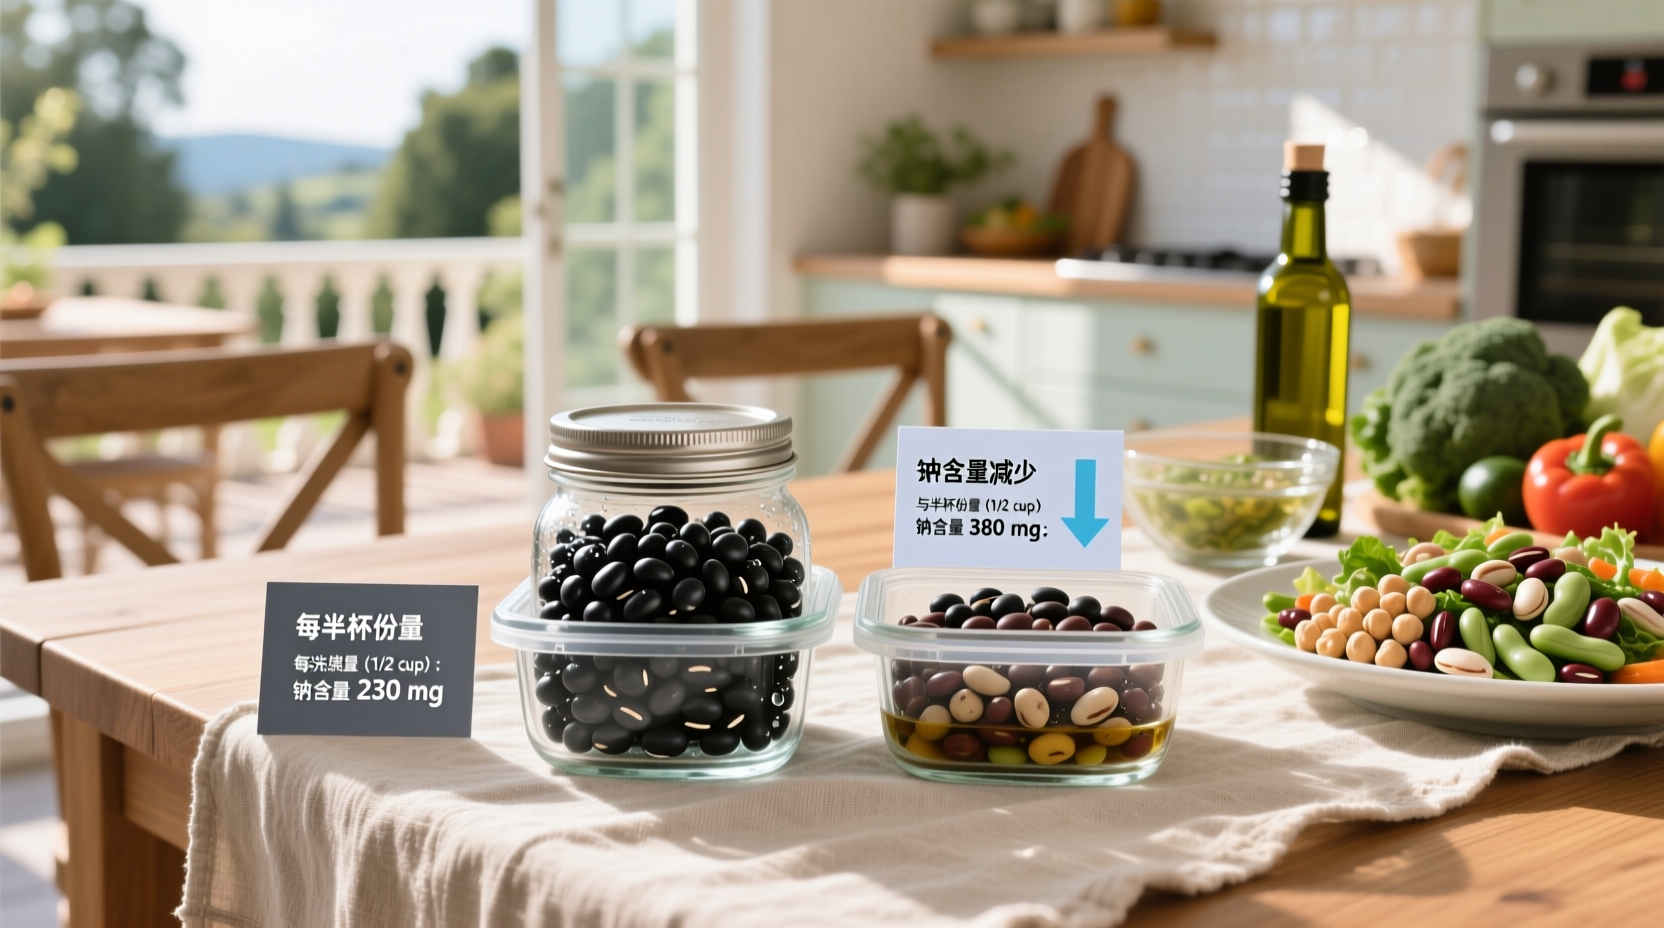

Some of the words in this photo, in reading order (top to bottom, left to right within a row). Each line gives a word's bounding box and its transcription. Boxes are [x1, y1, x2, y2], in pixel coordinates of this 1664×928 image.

[985, 498, 1009, 513] (1/2
[1013, 498, 1042, 516] cup)
[916, 517, 964, 536] 钠含量
[969, 518, 1005, 536] 380
[296, 612, 424, 641] 每半杯份量
[364, 655, 394, 674] (1/2
[293, 679, 350, 701] 钠含量
[357, 678, 401, 701] 230
[407, 684, 444, 708] mg
